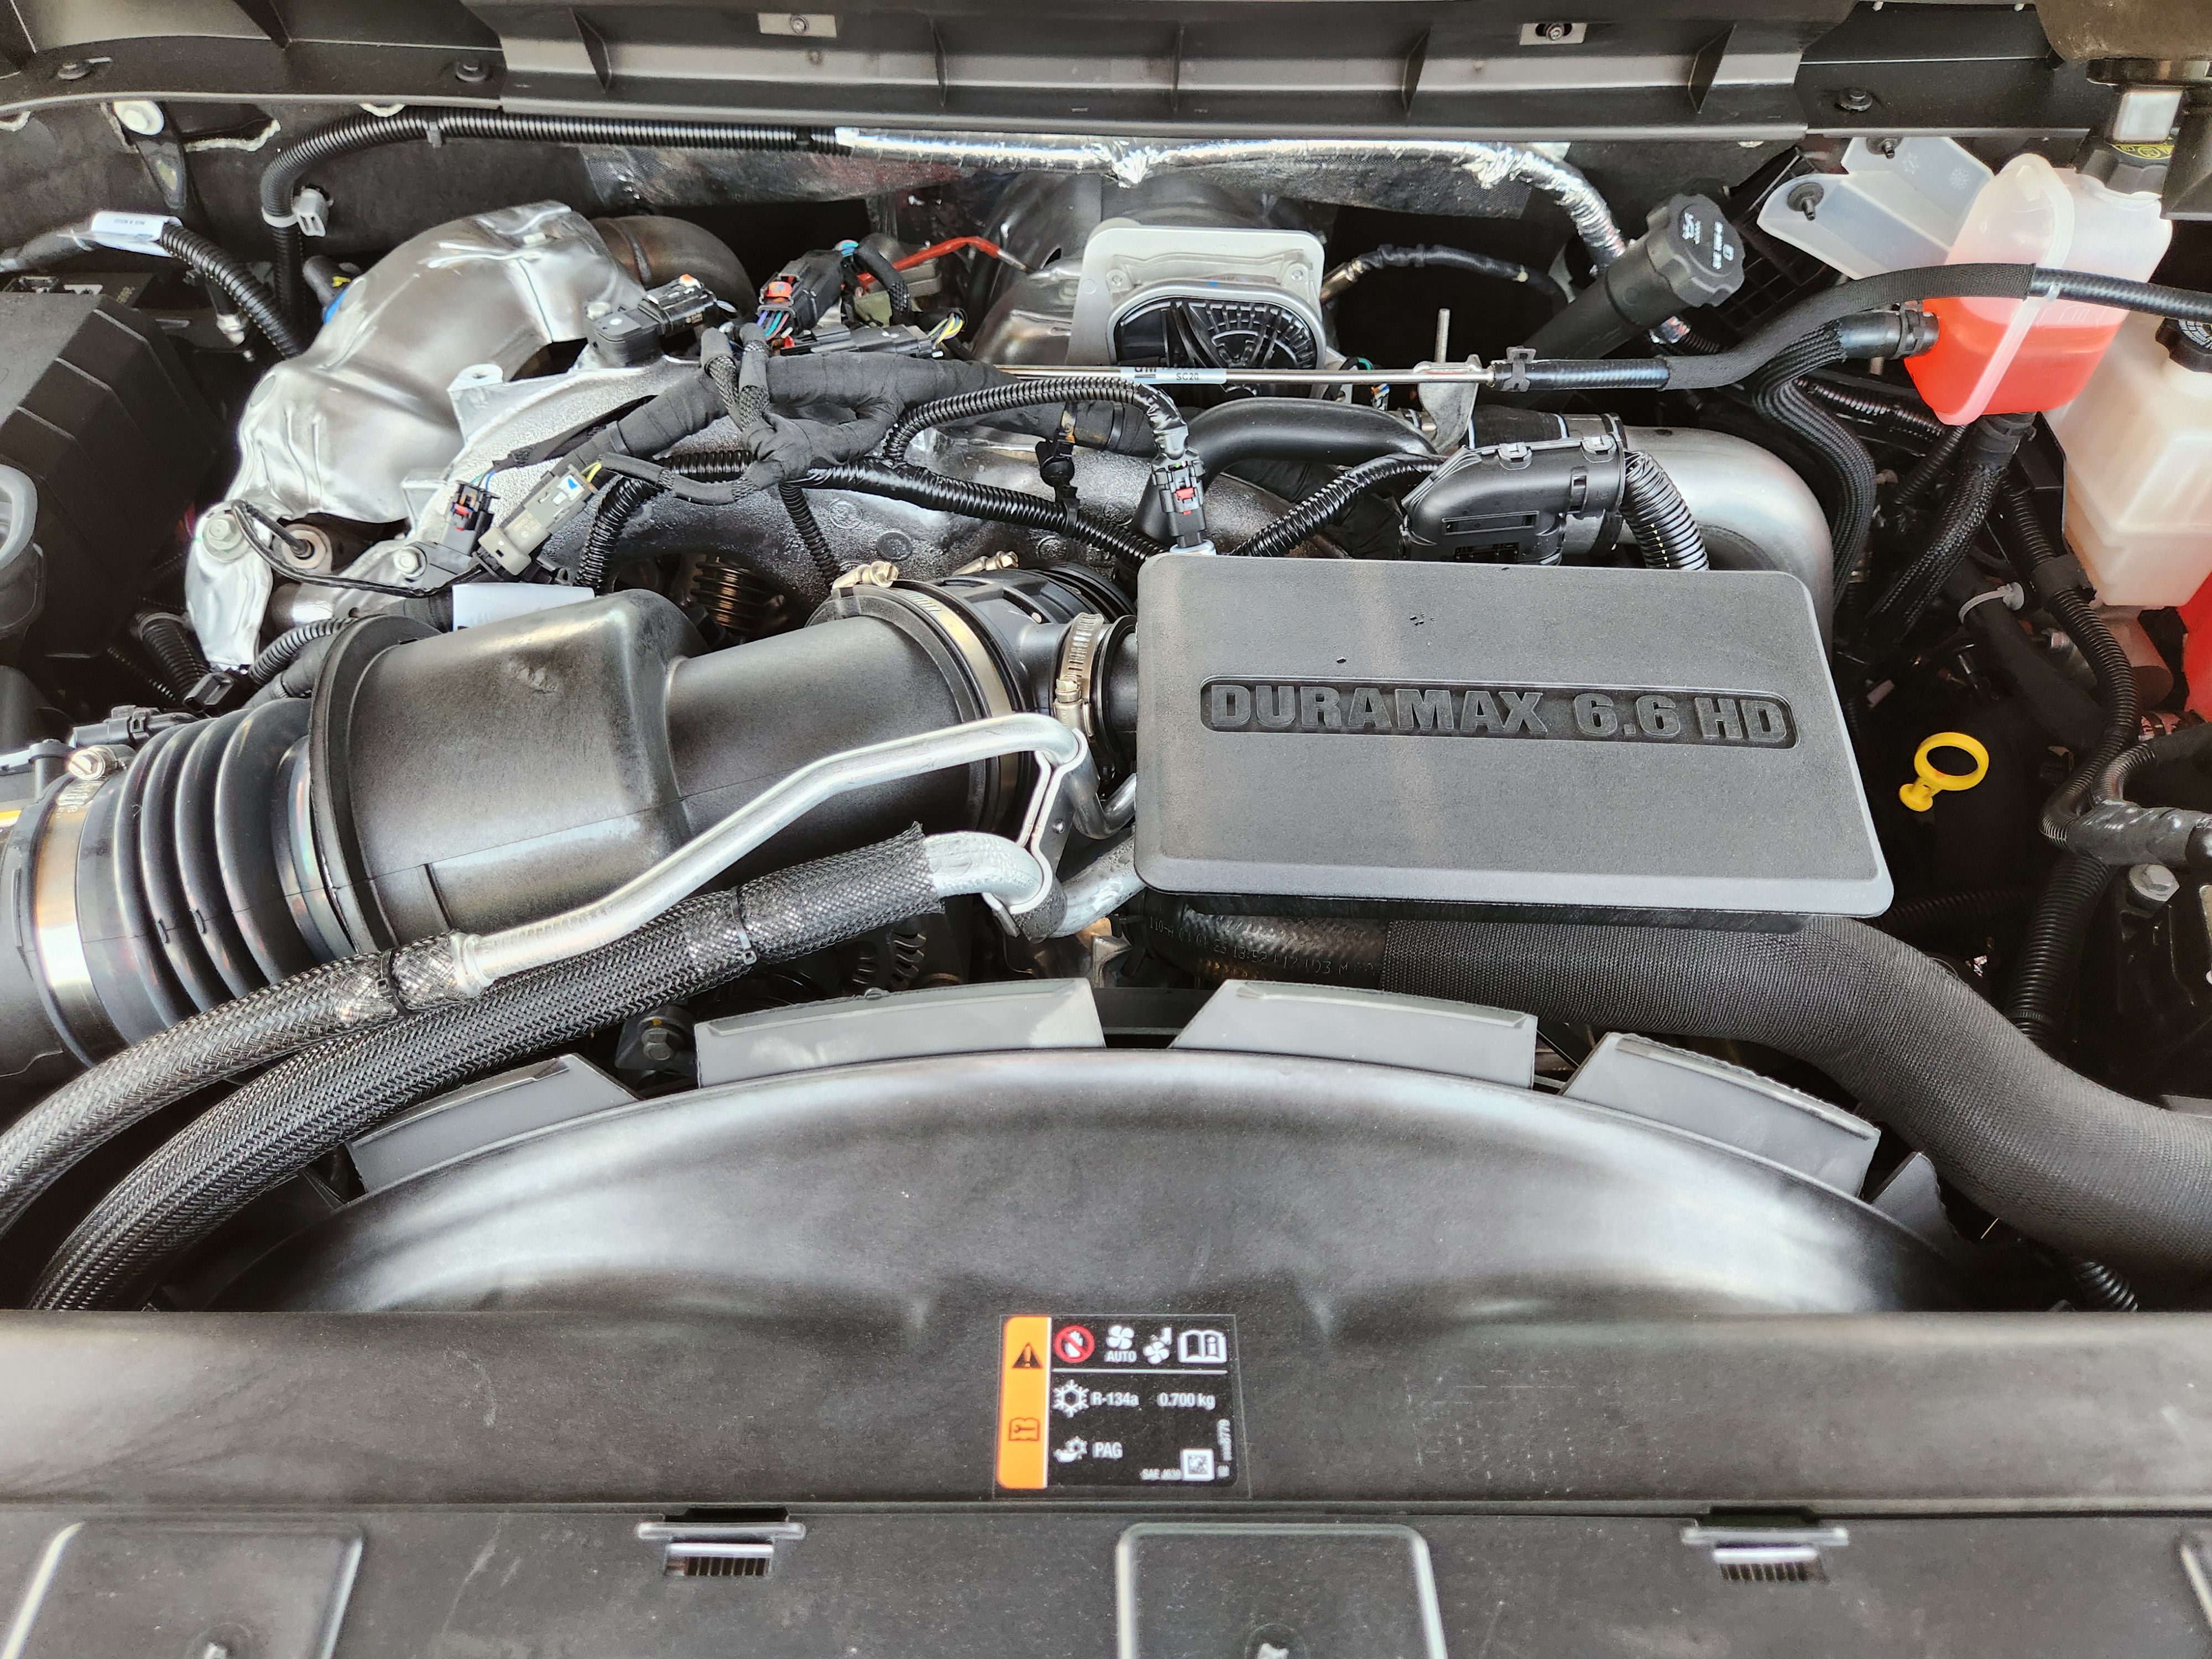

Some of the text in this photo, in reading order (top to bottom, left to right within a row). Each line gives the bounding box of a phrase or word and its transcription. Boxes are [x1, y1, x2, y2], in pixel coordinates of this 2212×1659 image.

[1211, 684, 1787, 742] DURAMAX 6.6 HD
[1107, 1350, 1137, 1362] AUTO
[1091, 1392, 1215, 1411] R-134a 0.700 kg
[1093, 1442, 1123, 1459] PAG
[1141, 1468, 1160, 1480] SAE
